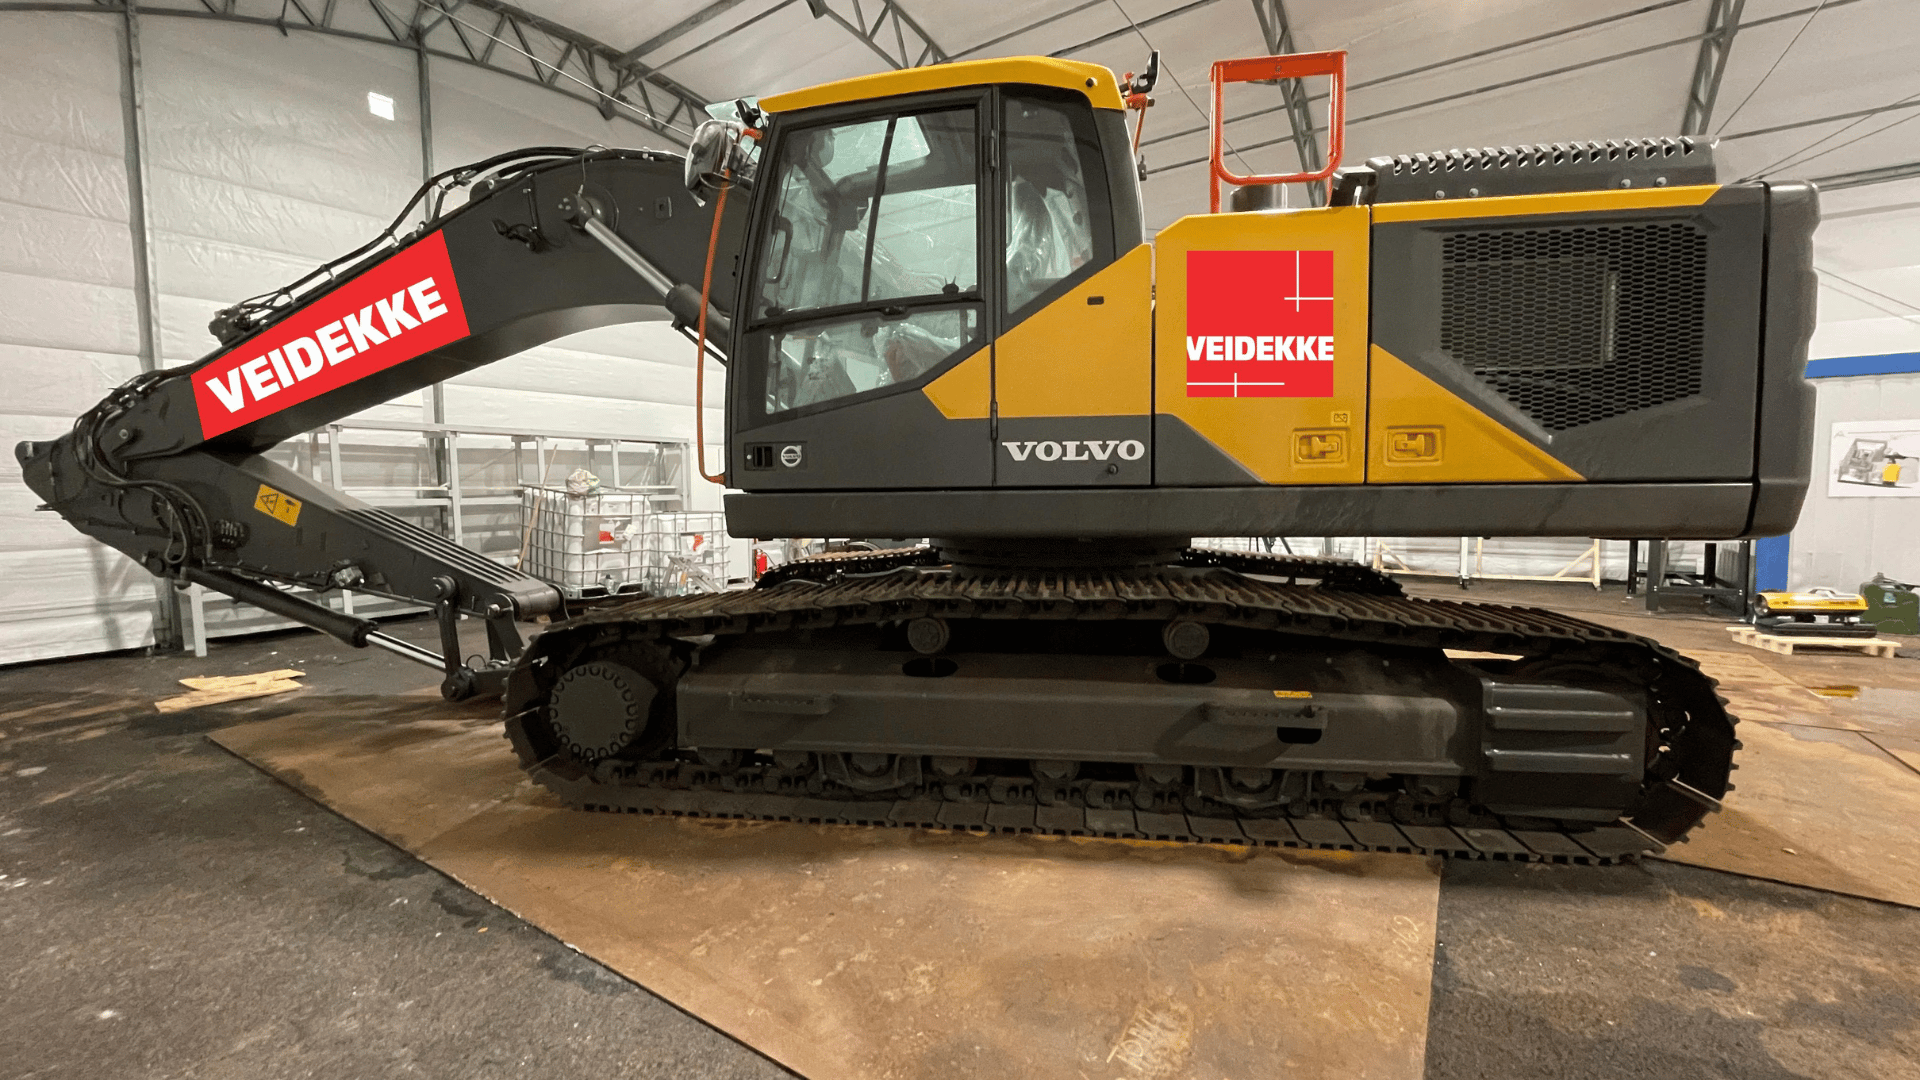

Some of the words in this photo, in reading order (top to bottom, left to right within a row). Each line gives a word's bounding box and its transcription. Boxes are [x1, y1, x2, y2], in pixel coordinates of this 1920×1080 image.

[205, 276, 449, 414] VEIDEKKE
[1187, 335, 1334, 361] VEIDEKKE
[1001, 439, 1146, 462] VOLVO
